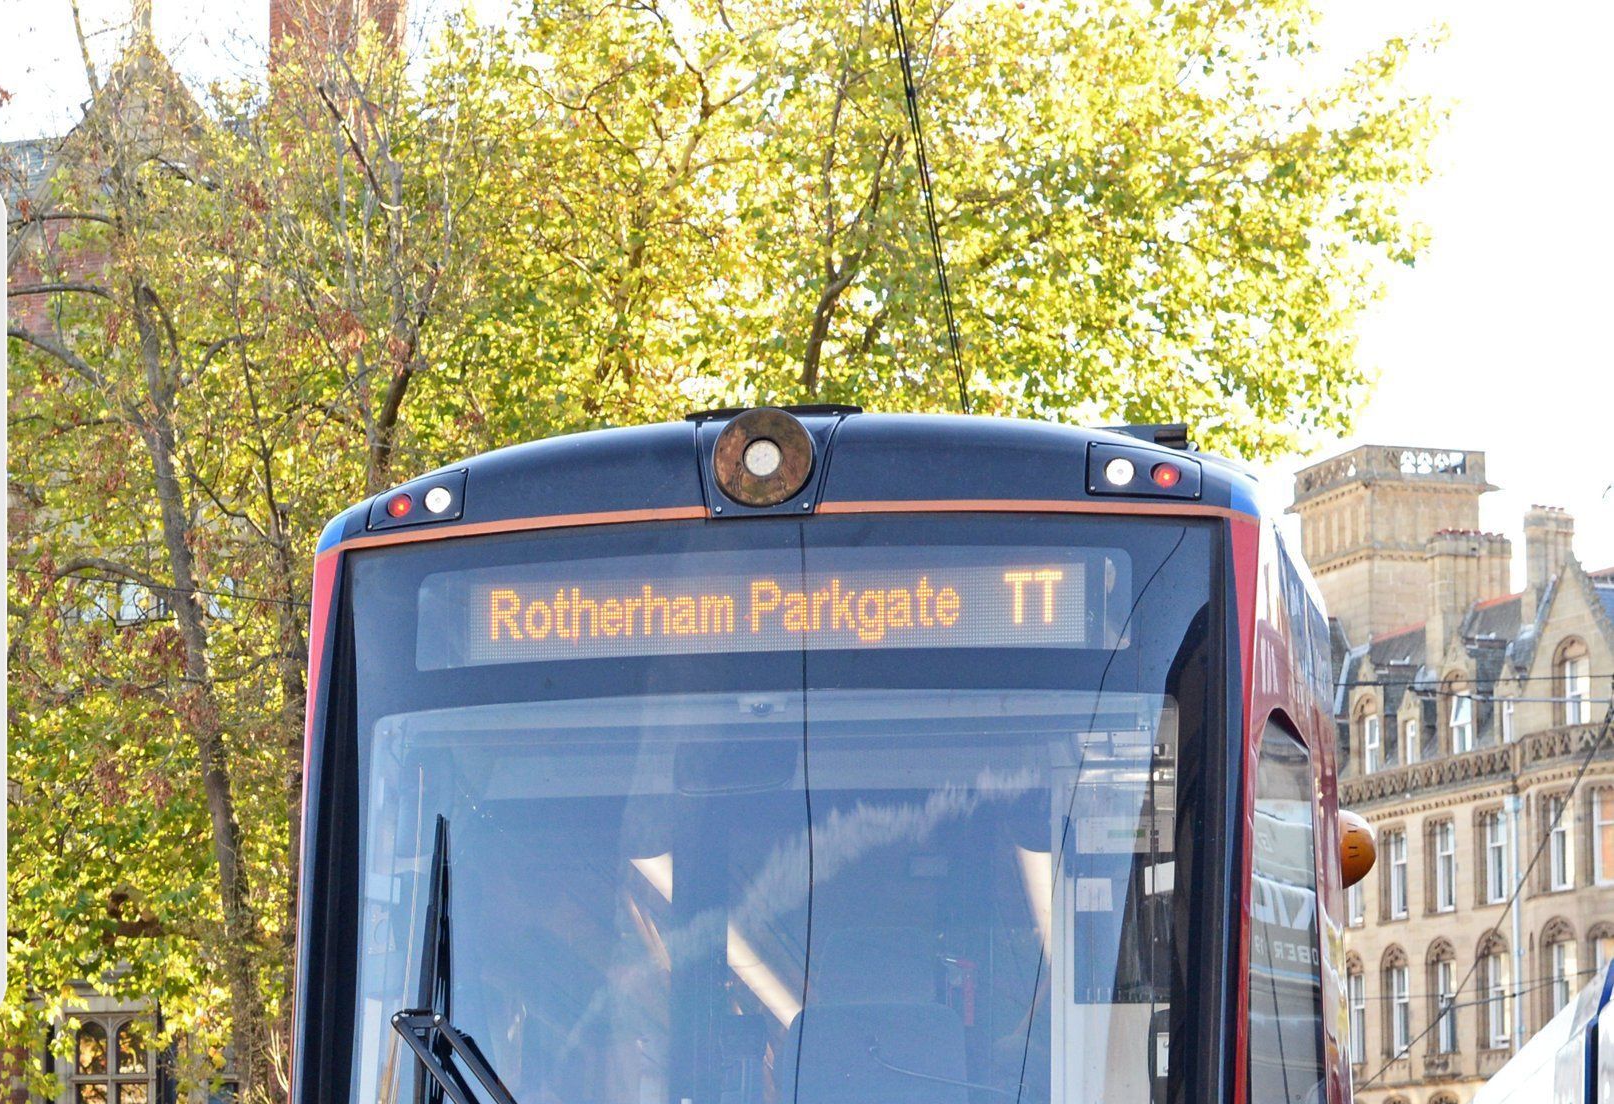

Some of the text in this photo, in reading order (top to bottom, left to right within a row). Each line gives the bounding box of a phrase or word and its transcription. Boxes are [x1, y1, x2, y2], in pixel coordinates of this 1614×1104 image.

[490, 570, 1064, 641] Rotherham Parkgate TT
